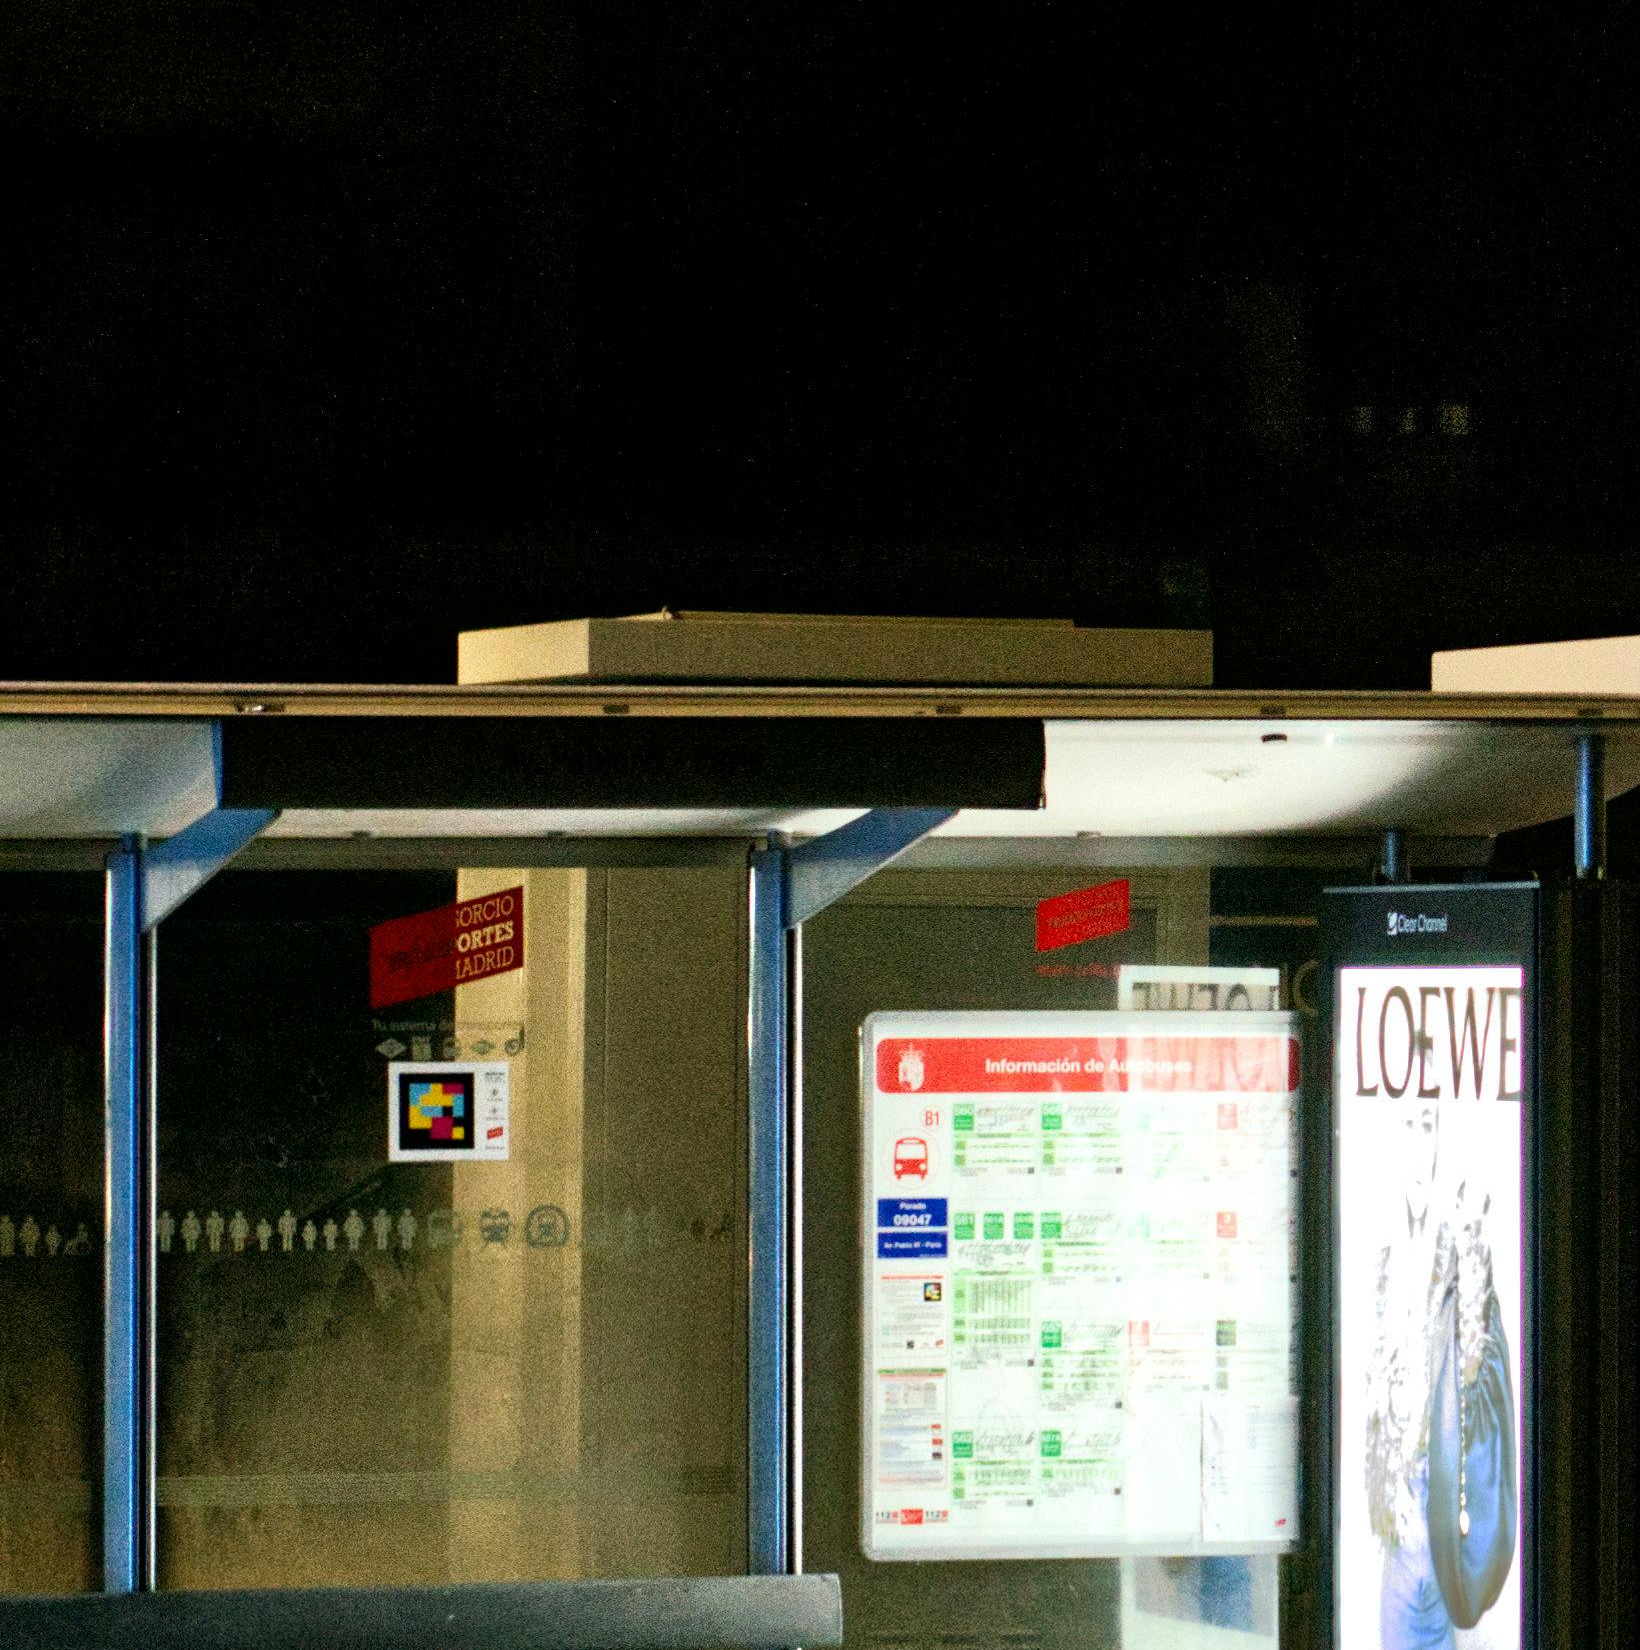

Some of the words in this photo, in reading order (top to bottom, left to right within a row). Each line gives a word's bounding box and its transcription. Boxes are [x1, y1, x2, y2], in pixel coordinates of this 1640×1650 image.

[456, 920, 514, 953] ORTES
[1356, 985, 1521, 1101] LOEWE
[985, 1057, 1080, 1074] Información
[1084, 1058, 1104, 1074] de
[1108, 1059, 1192, 1074] Autobuses
[894, 1214, 931, 1226] 09047
